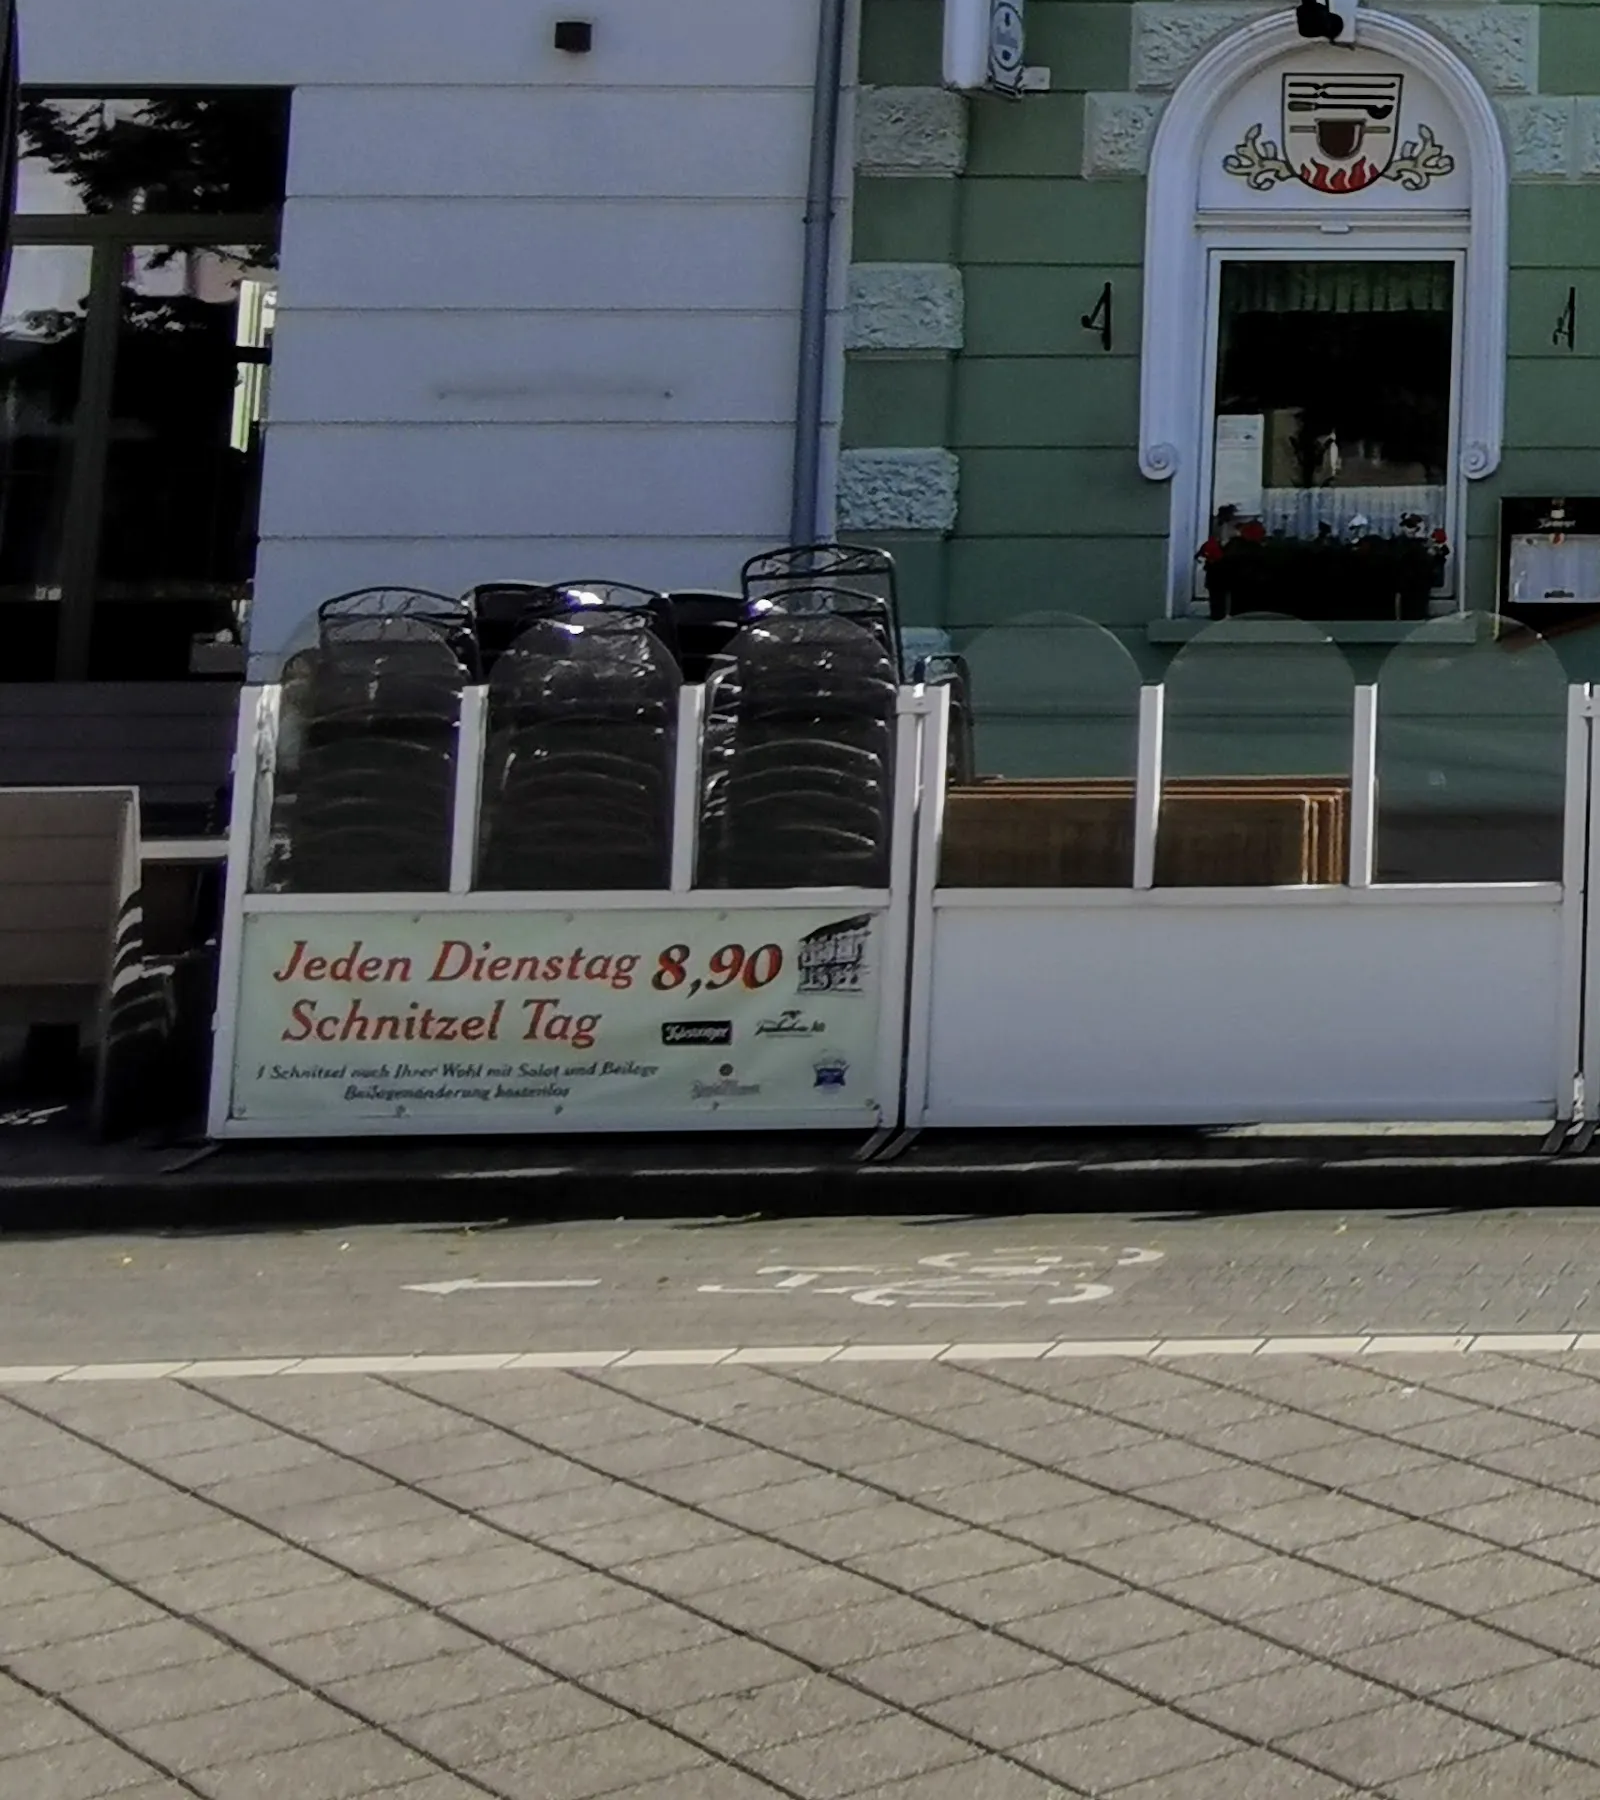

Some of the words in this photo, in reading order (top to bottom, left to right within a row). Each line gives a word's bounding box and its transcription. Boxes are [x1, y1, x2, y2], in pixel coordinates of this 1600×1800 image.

[273, 941, 411, 982] Jeden
[427, 940, 641, 990] Dienstag
[651, 943, 783, 1000] 8,90
[281, 998, 505, 1042] Schnitzel
[522, 999, 603, 1049] Tag
[270, 1064, 347, 1079] Schnitzel
[394, 1063, 438, 1079] Ihrer
